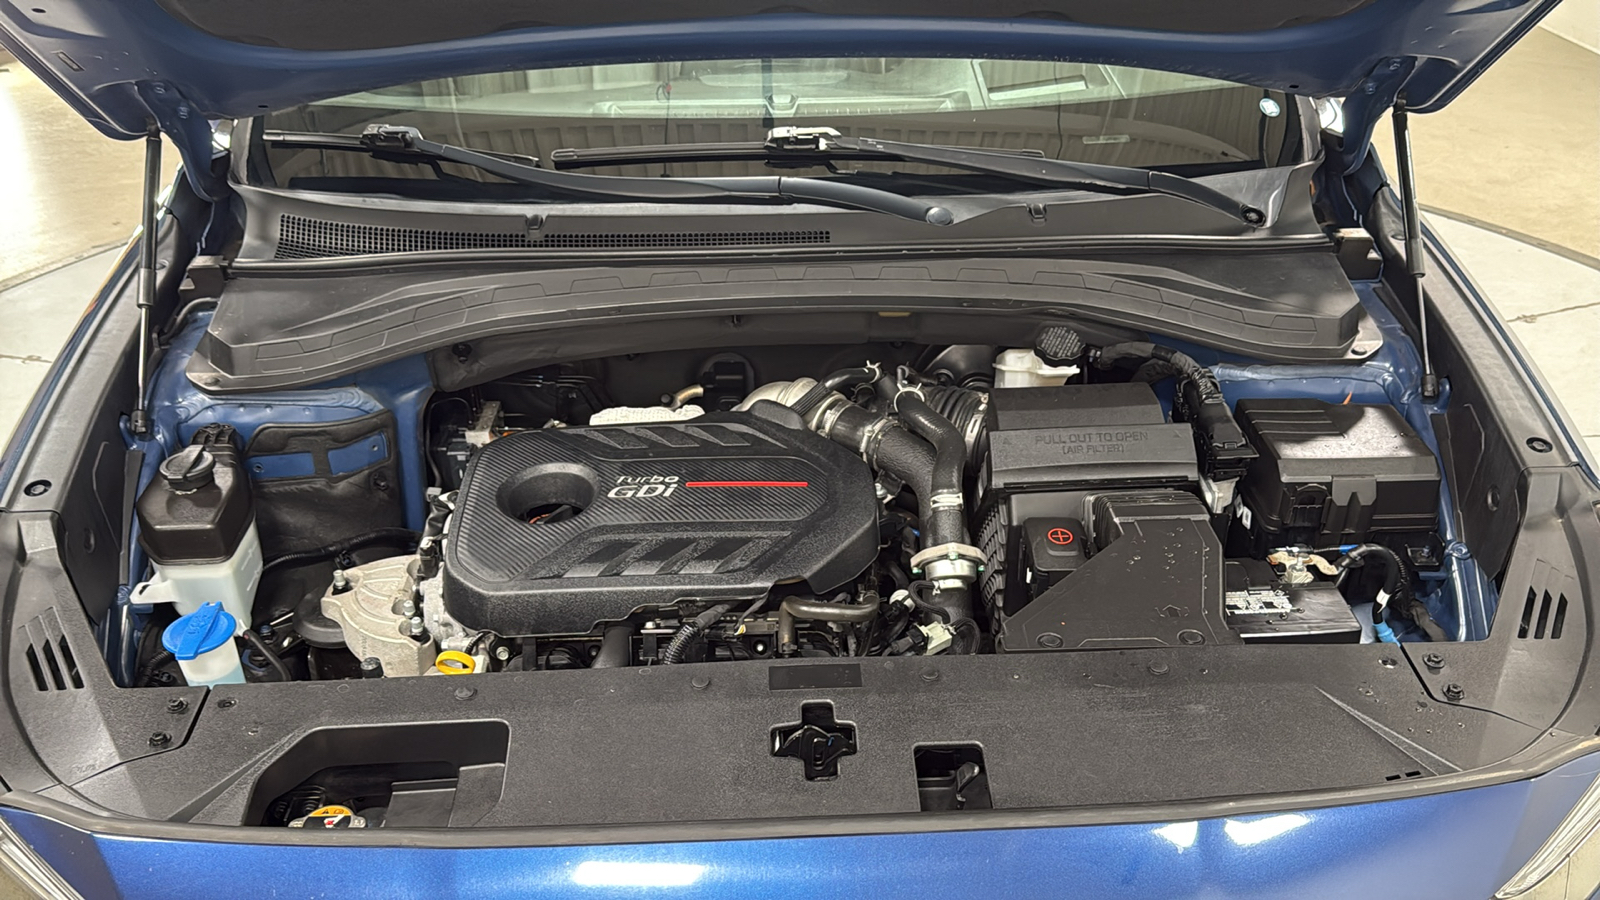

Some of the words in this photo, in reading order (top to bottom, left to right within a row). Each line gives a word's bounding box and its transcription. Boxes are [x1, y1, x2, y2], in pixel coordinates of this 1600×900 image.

[1035, 434, 1066, 445] PULL
[1068, 433, 1093, 443] OUT
[1095, 432, 1112, 442] TO
[1115, 431, 1148, 441] OPEN
[616, 475, 679, 483] Turbo
[607, 484, 678, 498] GDi
